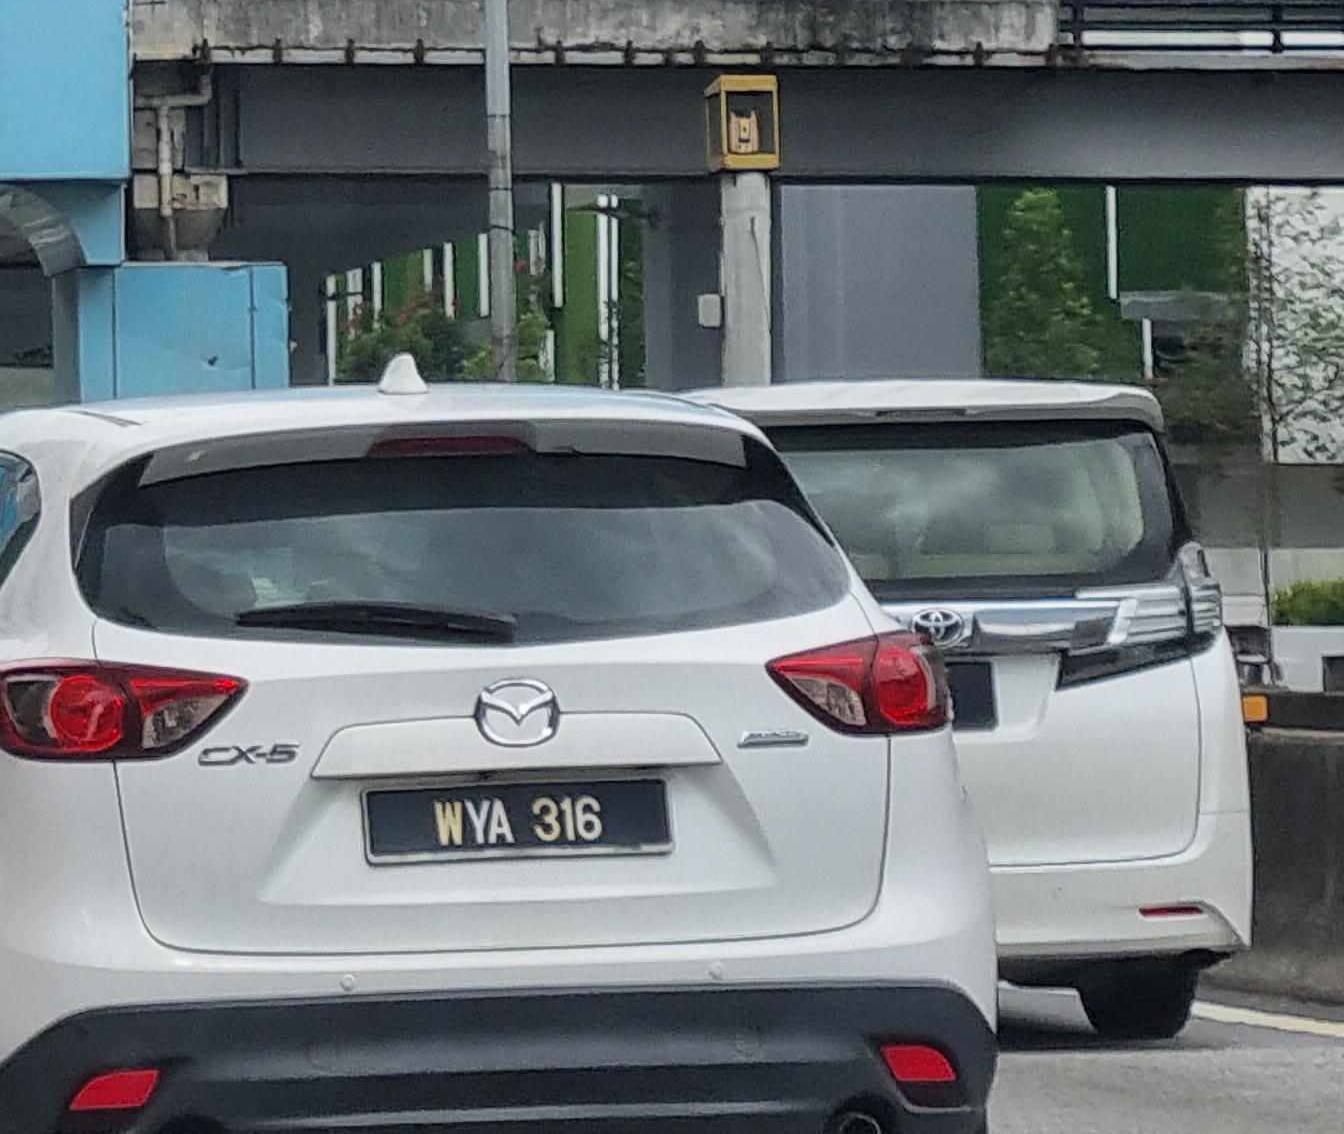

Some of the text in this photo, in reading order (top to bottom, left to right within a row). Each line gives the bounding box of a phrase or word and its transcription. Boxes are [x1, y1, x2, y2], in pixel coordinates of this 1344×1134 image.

[197, 744, 300, 766] CX-5
[434, 794, 602, 847] WYA 316
